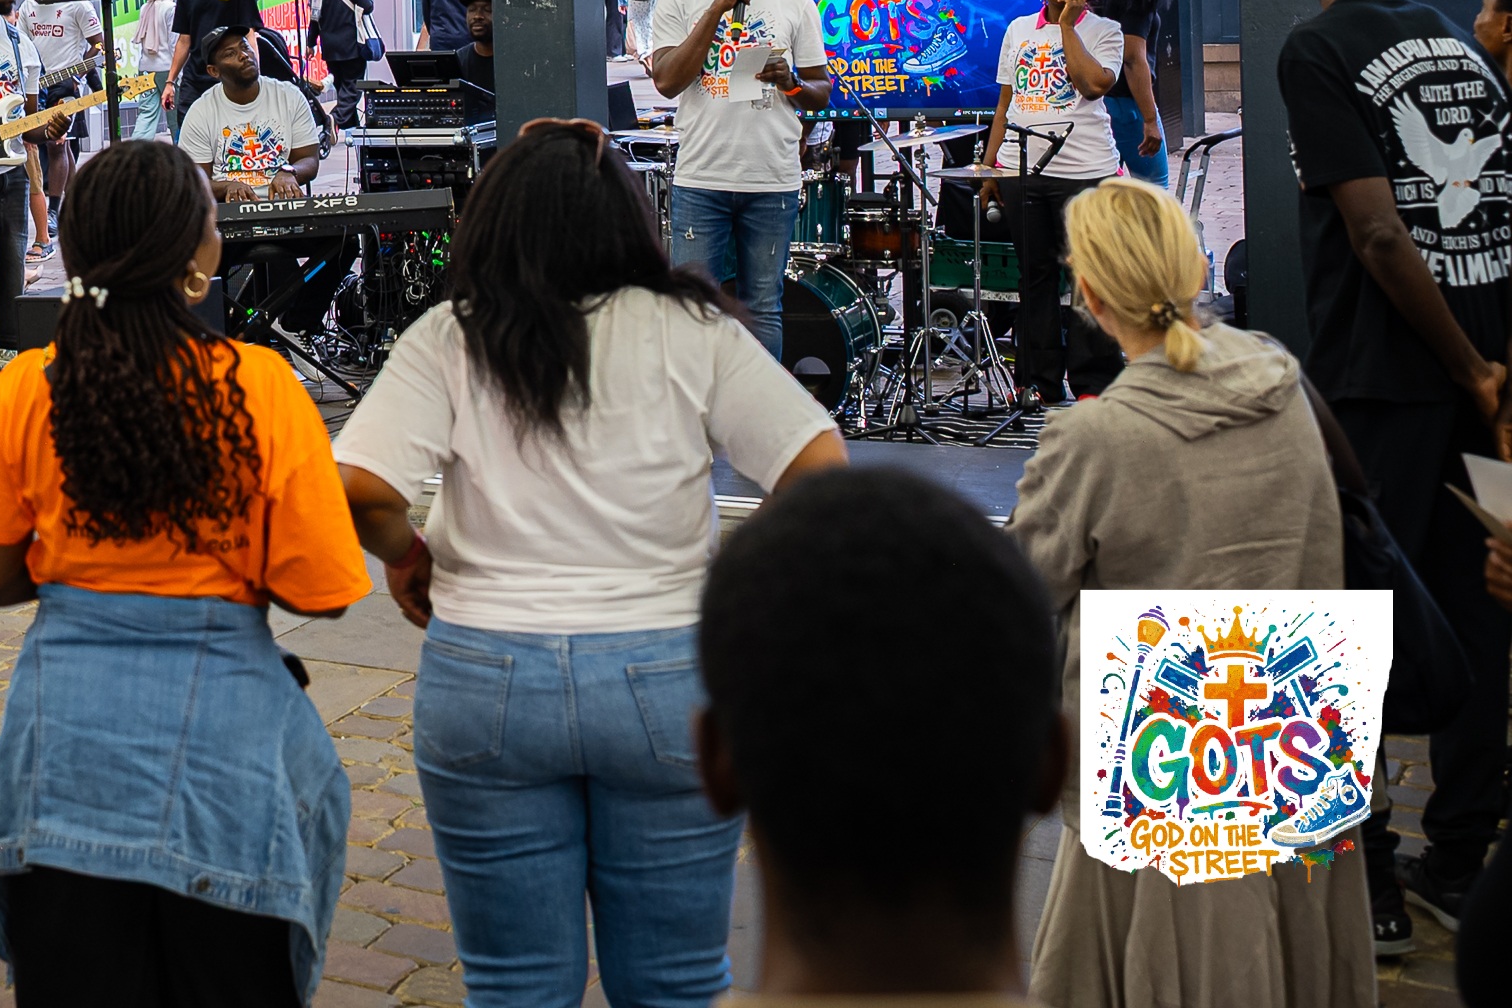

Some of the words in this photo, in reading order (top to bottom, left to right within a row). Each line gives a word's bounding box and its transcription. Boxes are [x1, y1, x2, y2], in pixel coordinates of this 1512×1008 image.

[33, 22, 52, 30] Team
[828, 58, 850, 77] OD
[852, 58, 870, 75] ON
[872, 58, 897, 75] THE
[1360, 59, 1392, 88] AM
[1381, 38, 1432, 71] ALPHA
[1427, 37, 1465, 56] AND
[839, 74, 909, 94] STREET
[1016, 66, 1067, 90] GOTS
[1372, 82, 1395, 107] THE
[1389, 60, 1436, 89] BEGINNING
[1437, 59, 1459, 71] AND
[1454, 80, 1486, 100] THE
[1021, 104, 1050, 112] STREET
[239, 200, 307, 213] MOTIF
[313, 195, 358, 209] XF8
